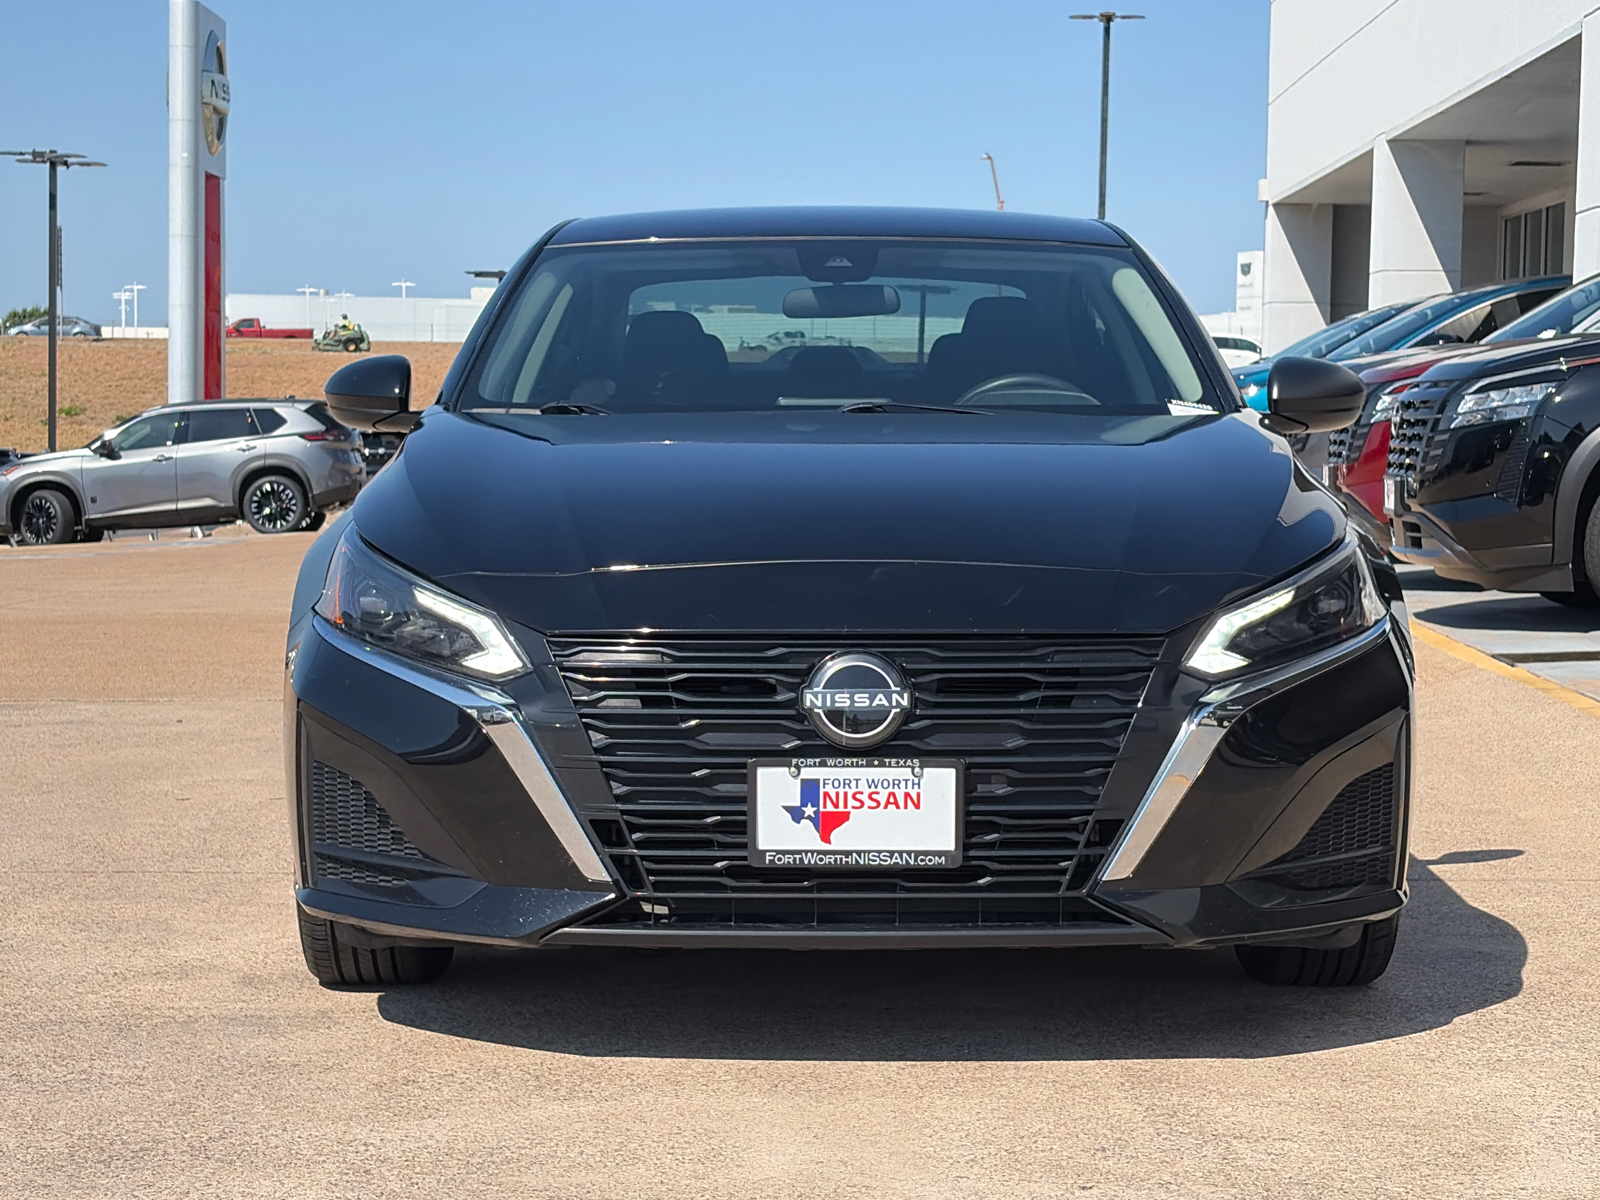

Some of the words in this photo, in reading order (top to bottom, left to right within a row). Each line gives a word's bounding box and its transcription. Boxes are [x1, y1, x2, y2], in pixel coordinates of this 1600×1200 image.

[806, 693, 908, 707] NISSAN
[791, 758, 821, 767] FORT
[826, 758, 866, 767] WORTH
[884, 758, 920, 767] TEXAS
[822, 778, 862, 790] FORT
[866, 778, 921, 790] WORTH
[822, 791, 921, 810] NISSAN
